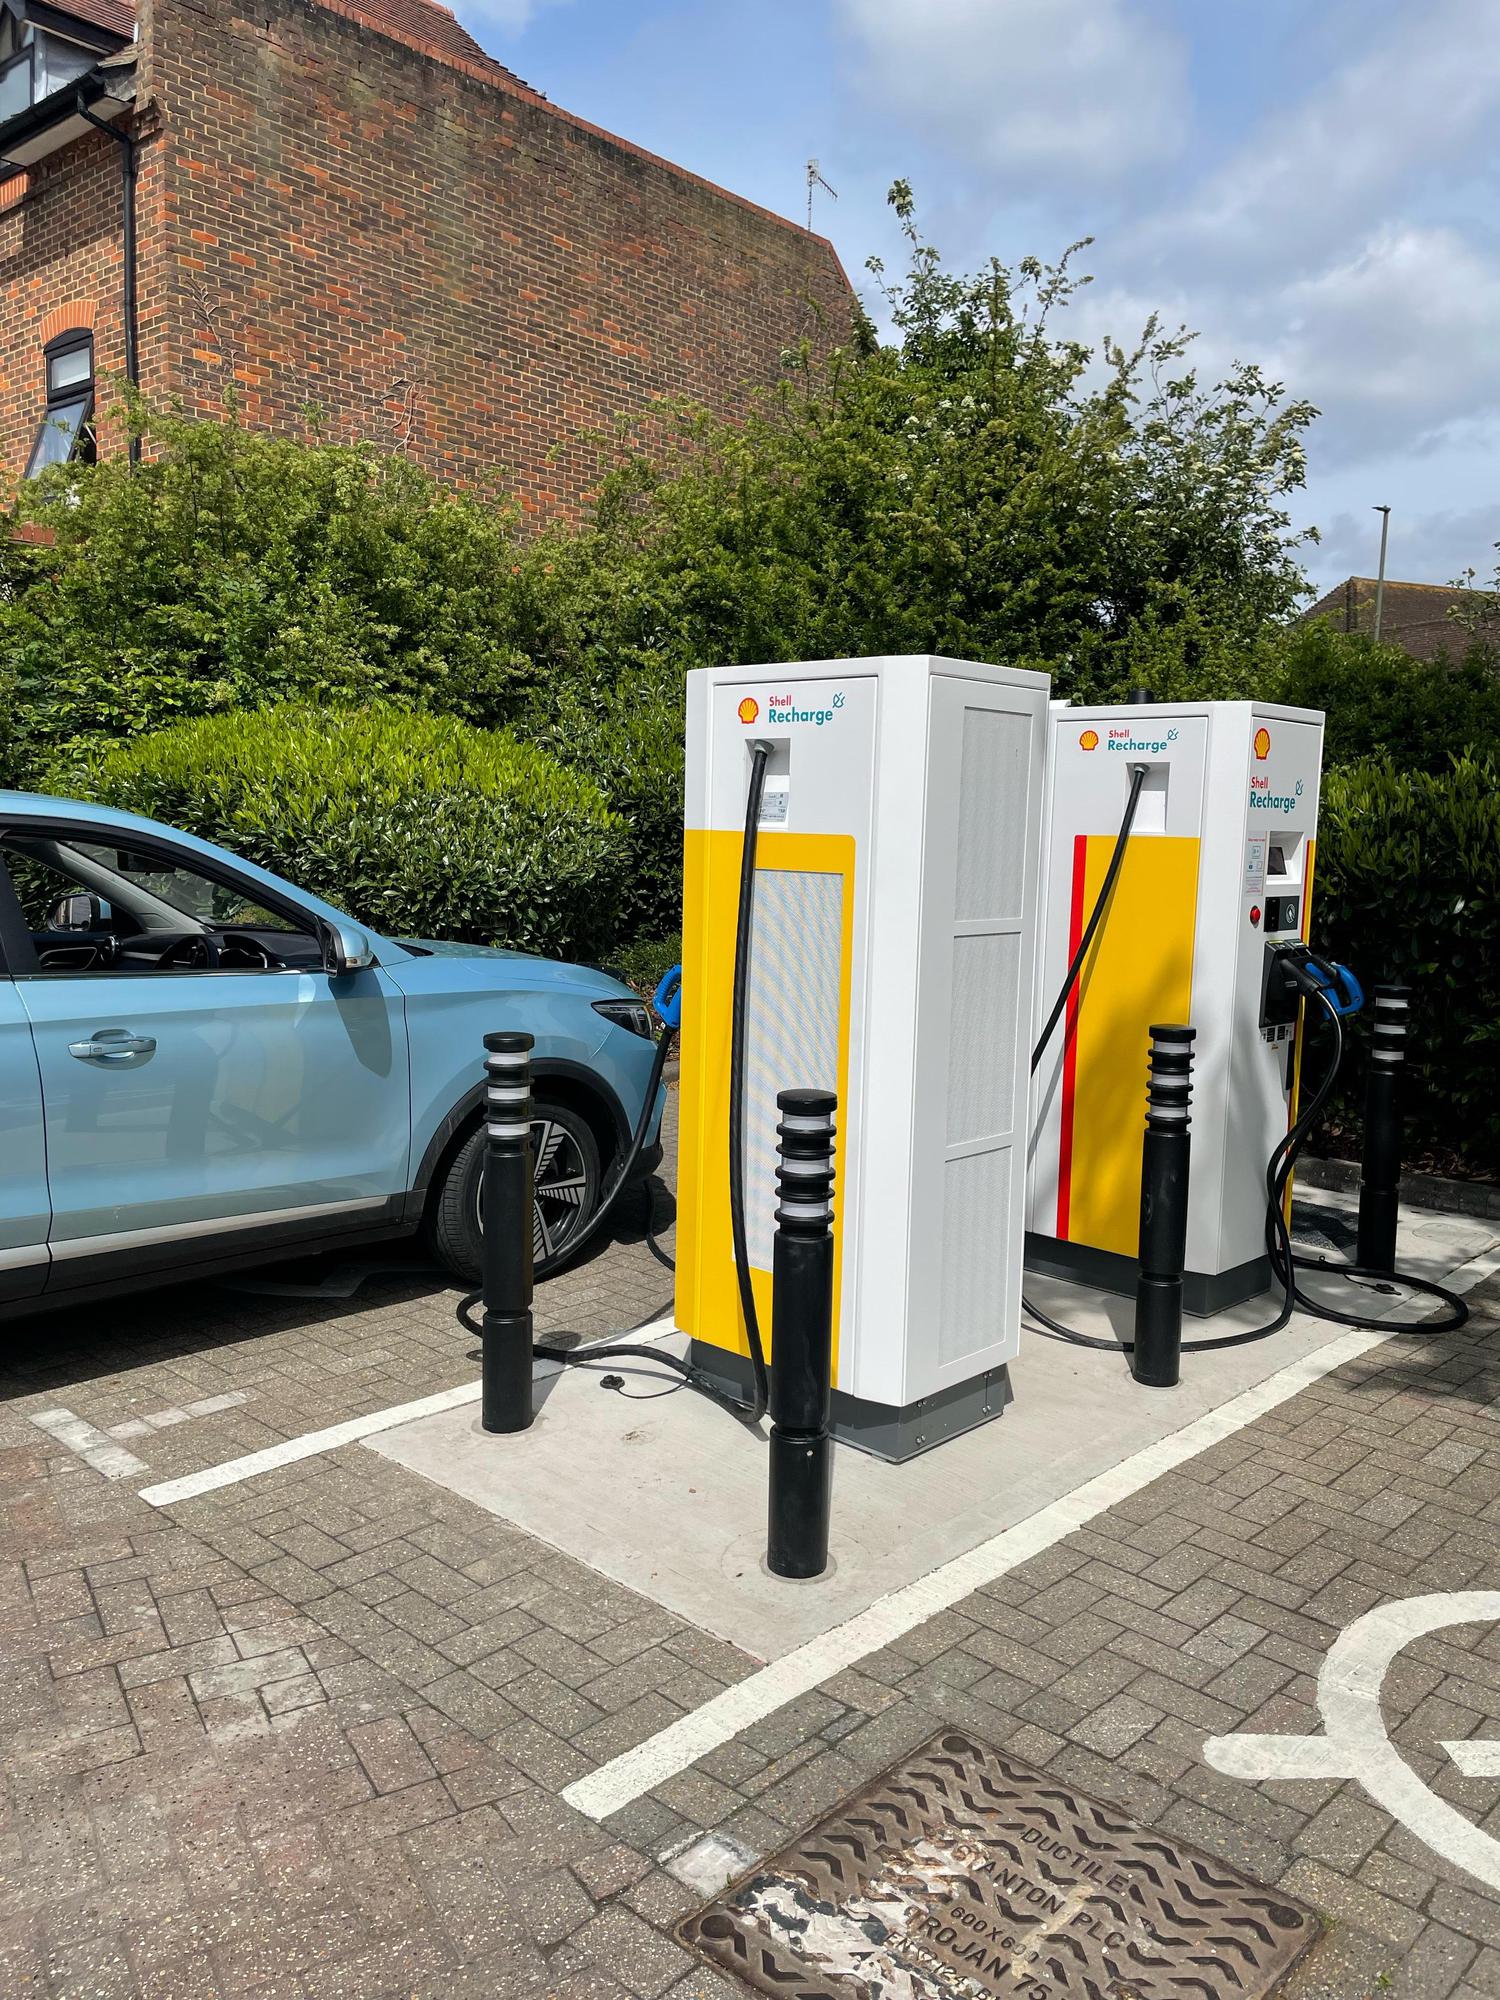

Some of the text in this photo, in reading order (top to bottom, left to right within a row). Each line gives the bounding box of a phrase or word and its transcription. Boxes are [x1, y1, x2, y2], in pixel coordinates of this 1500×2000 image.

[769, 695, 792, 706] Shell
[768, 706, 834, 726] Recharge
[1108, 729, 1130, 738] Shell
[1107, 738, 1168, 754] Recharge
[1251, 776, 1269, 789] Shell
[1249, 790, 1296, 814] Recharge
[1020, 1826, 1129, 1894] DUCTILE
[1069, 1911, 1126, 1949] PLC
[903, 1904, 1053, 2000] TROJAN 75
